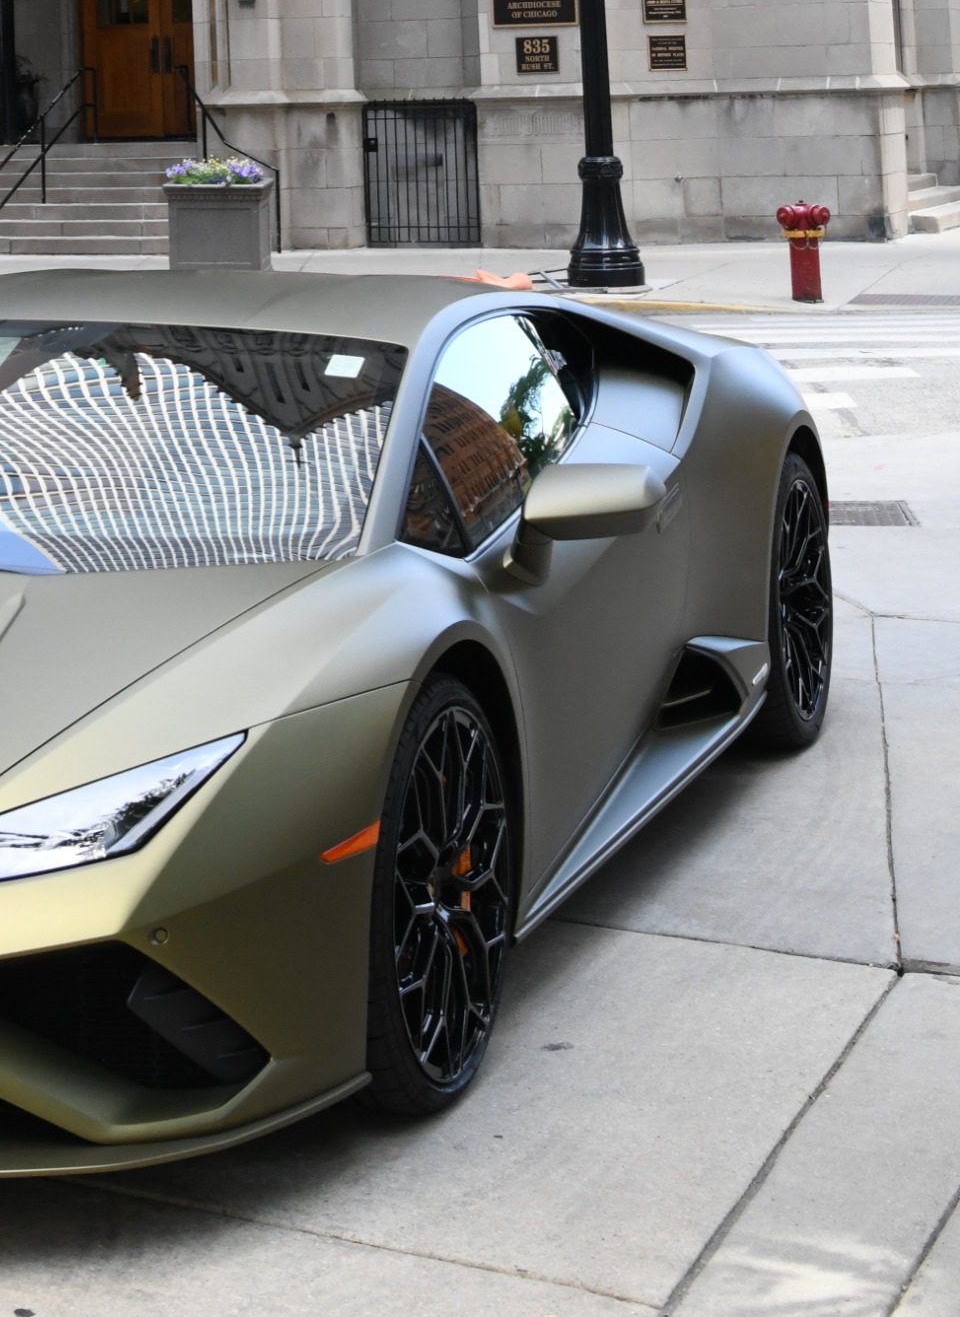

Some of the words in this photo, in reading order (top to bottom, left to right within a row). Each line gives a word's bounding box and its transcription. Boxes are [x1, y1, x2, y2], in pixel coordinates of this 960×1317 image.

[507, 0, 561, 9] ARCHDIOCESE
[511, 11, 522, 19] OF
[523, 10, 558, 18] CHICAGO
[523, 39, 550, 54] 835
